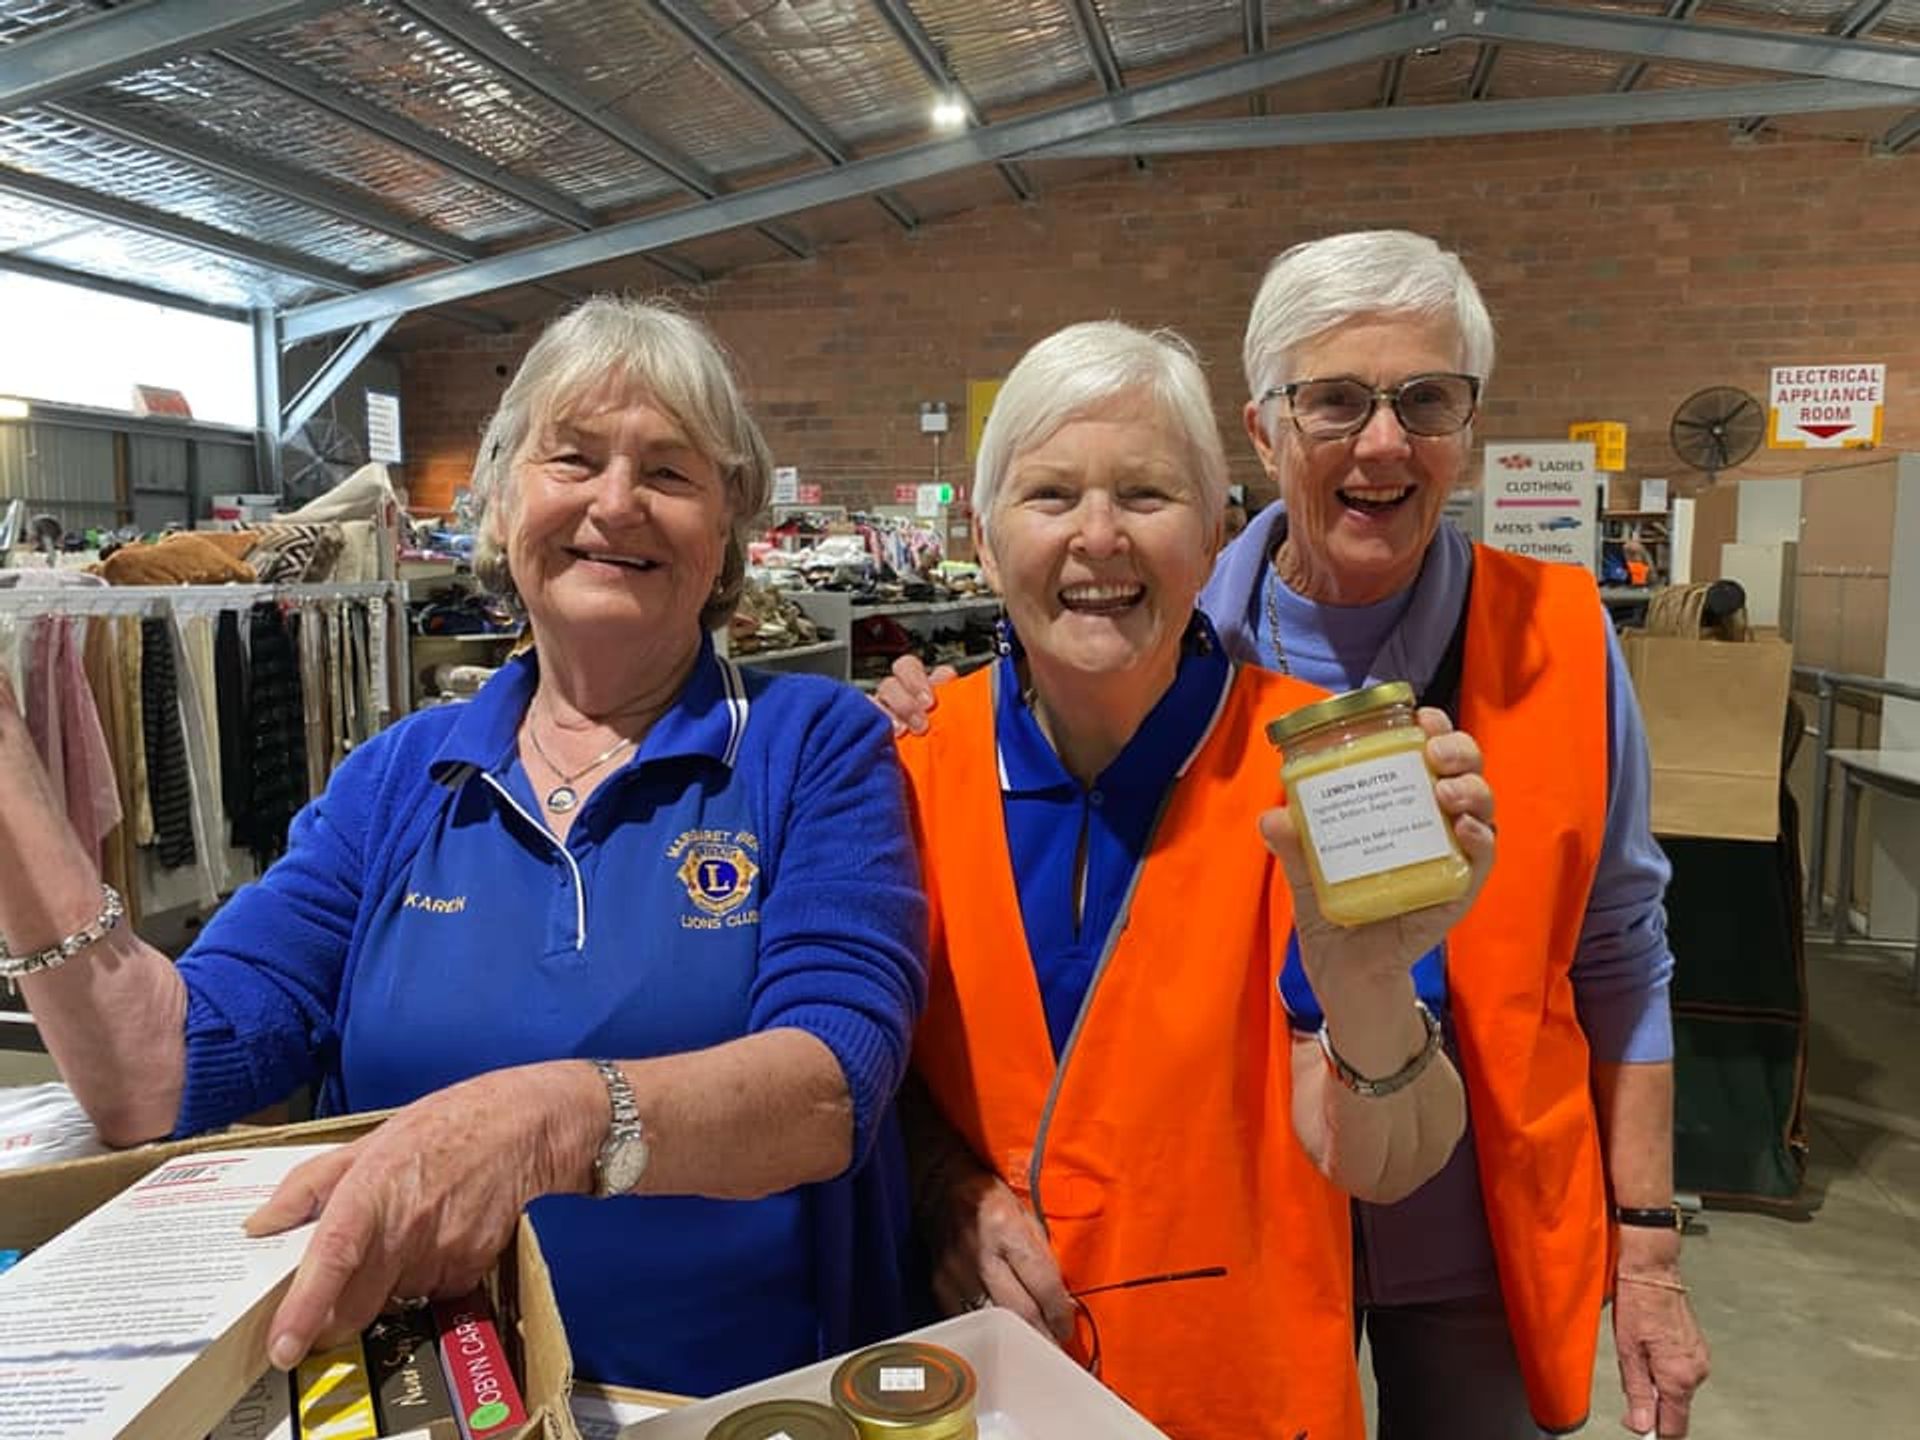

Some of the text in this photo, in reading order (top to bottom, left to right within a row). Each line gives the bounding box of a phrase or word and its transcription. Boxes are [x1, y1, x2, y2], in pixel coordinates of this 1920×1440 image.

[1776, 368, 1880, 385] ELECTRICAL
[1777, 387, 1878, 403] APPLIANCE
[1800, 406, 1851, 420] ROOM
[1539, 461, 1584, 473] LADIES
[1505, 481, 1573, 494] CLOTHING
[1494, 522, 1534, 535] MENS
[1504, 543, 1573, 555] CLOTHING
[704, 863, 731, 892] L
[403, 893, 467, 913] KAREN
[681, 914, 722, 930] LIONS
[466, 1354, 503, 1406] OBYN
